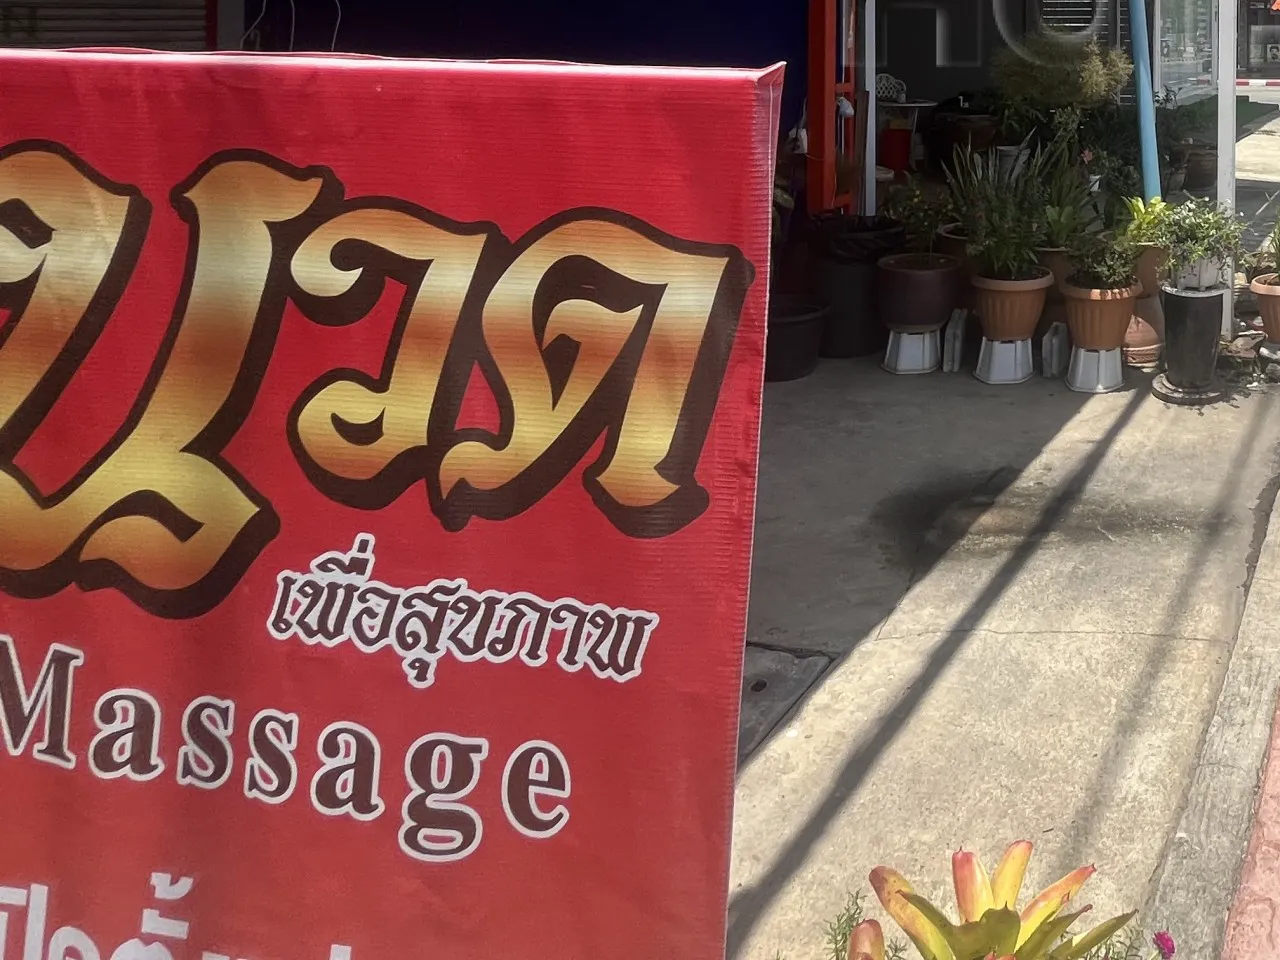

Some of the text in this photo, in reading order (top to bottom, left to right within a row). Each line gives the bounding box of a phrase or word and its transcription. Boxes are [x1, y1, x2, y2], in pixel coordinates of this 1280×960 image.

[266, 532, 659, 688] เพื่อสุขภาพ
[0, 630, 573, 862] Massage
